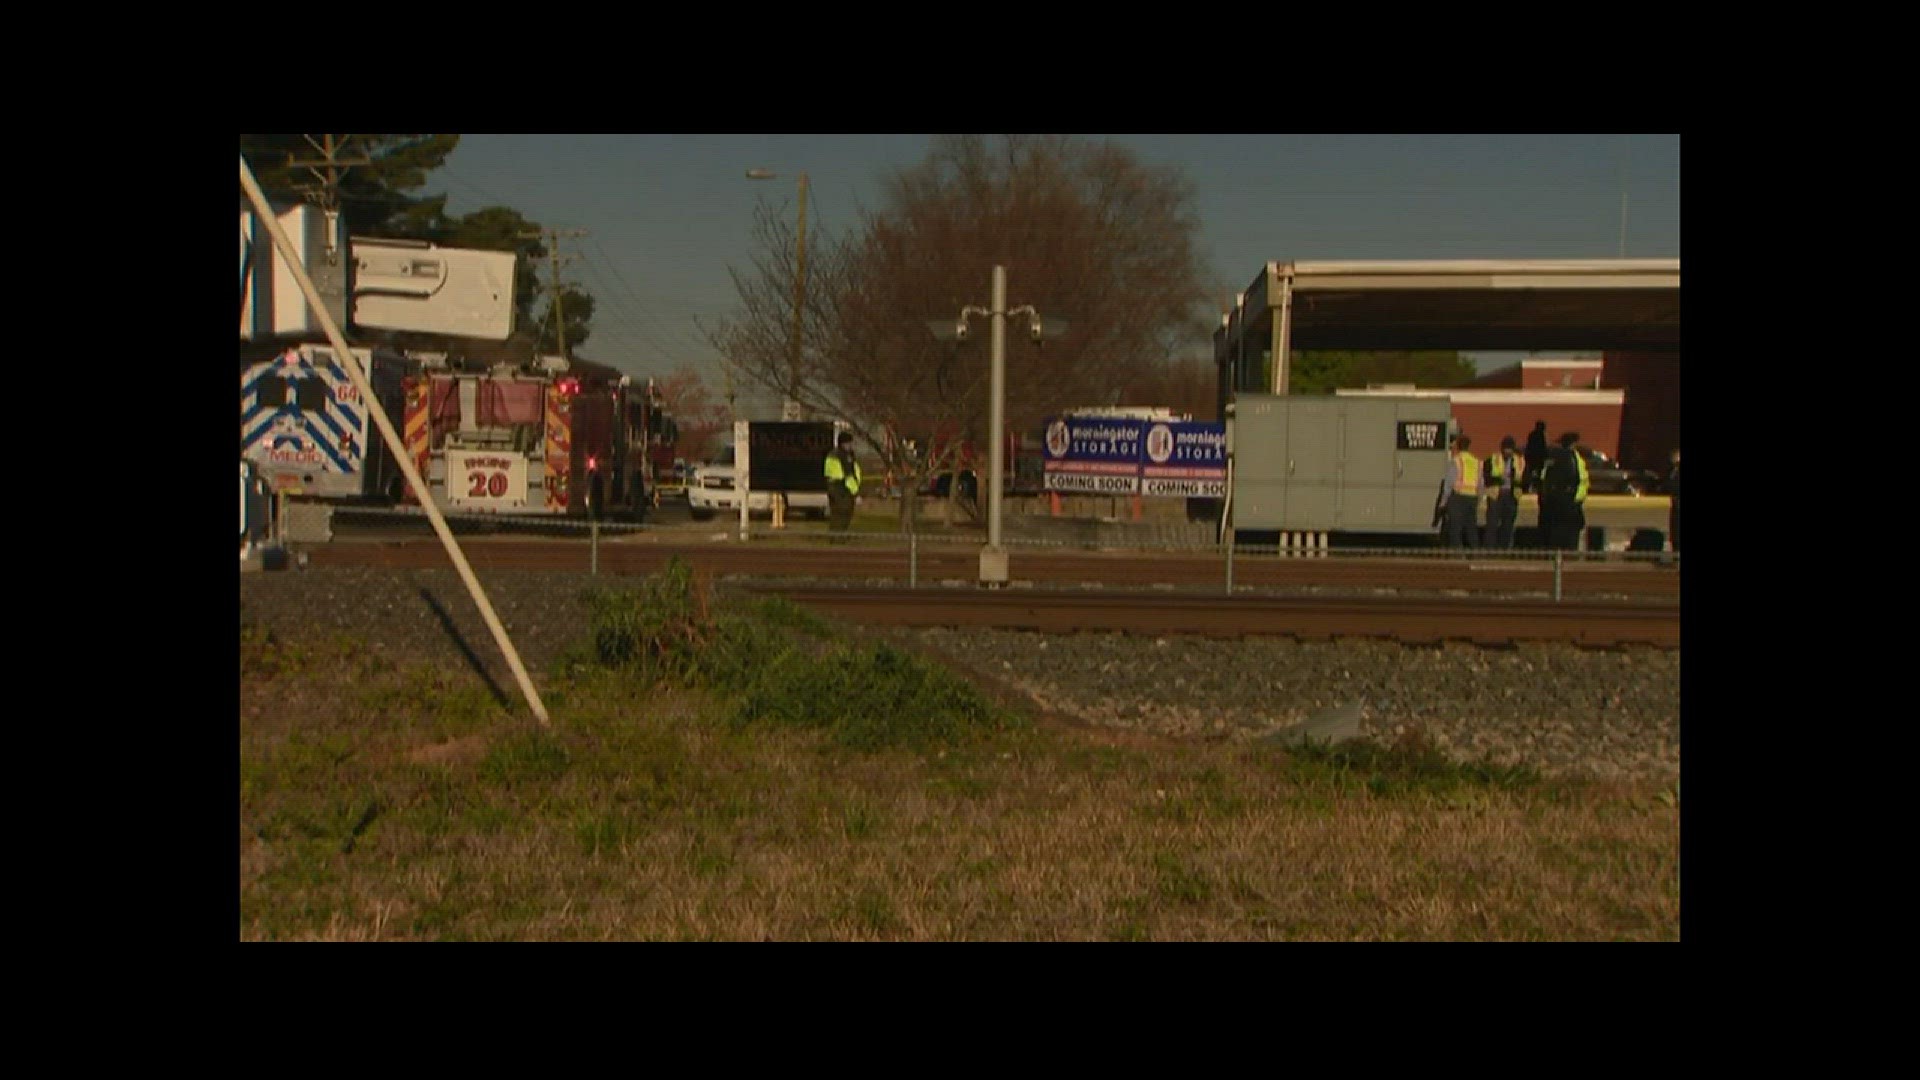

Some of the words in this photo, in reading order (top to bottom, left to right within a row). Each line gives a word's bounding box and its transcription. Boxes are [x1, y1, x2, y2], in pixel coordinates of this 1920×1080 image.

[1072, 424, 1139, 444] morningstar
[270, 450, 320, 462] MEDIC
[1073, 442, 1138, 456] STORAGE
[464, 456, 512, 470] ENGINE
[468, 471, 509, 498] 20
[1049, 475, 1094, 489] COMING
[1099, 477, 1132, 491] SOON
[1147, 480, 1199, 494] COMING
